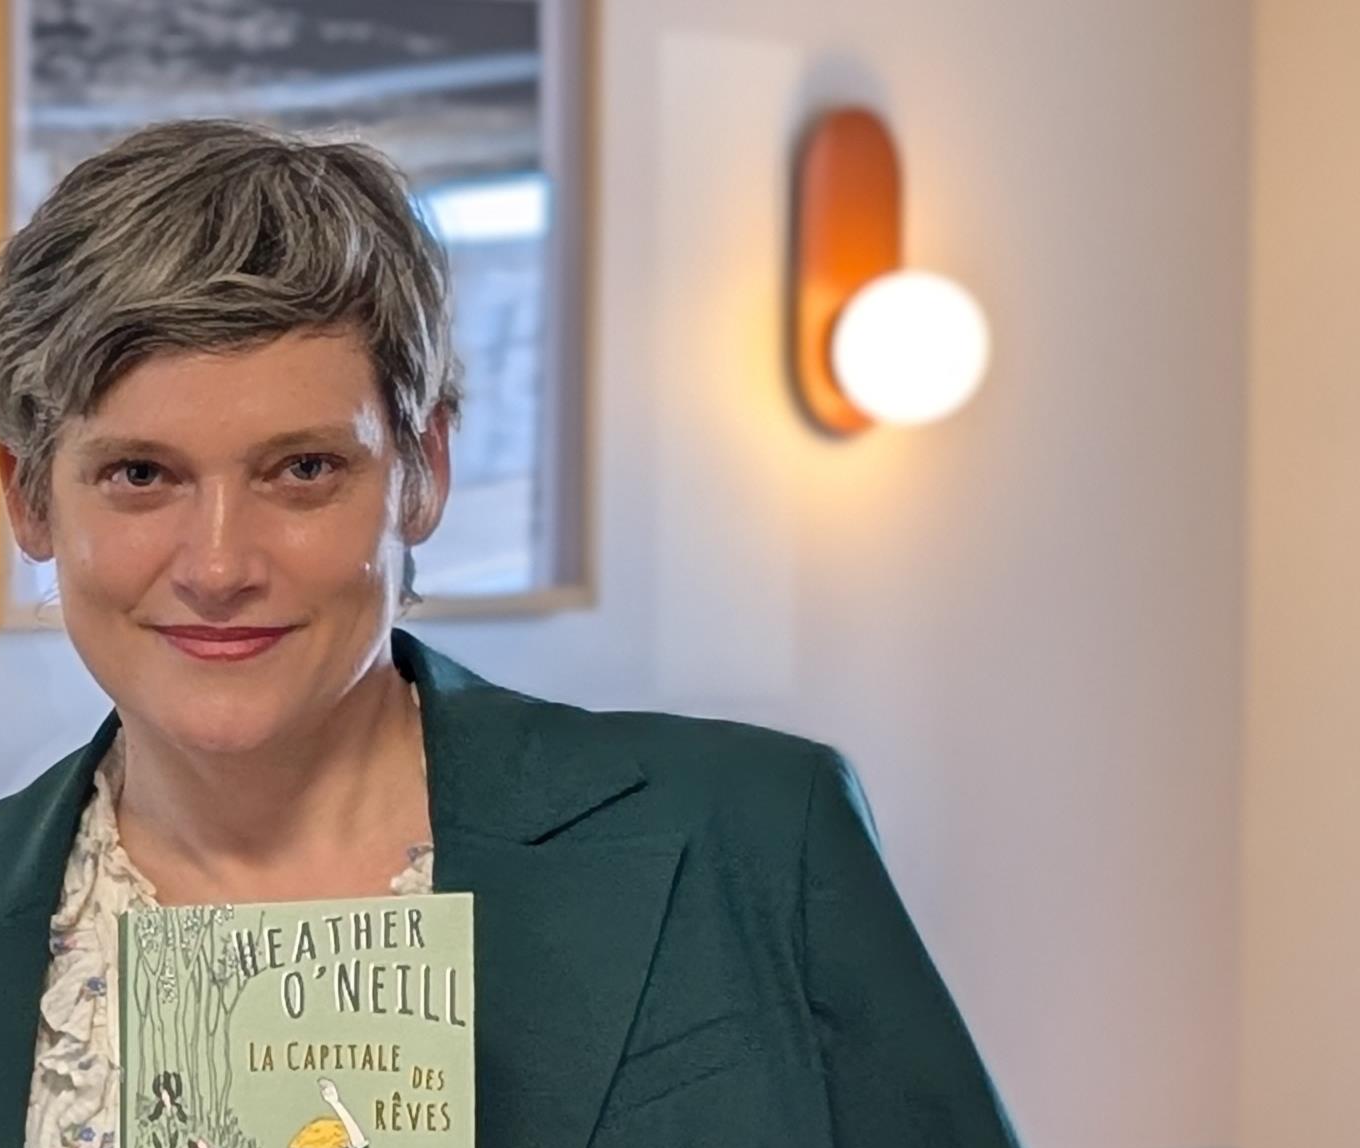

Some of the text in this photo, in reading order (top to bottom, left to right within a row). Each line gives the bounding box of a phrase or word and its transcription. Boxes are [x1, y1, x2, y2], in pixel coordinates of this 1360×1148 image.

[233, 907, 425, 978] HEATHER
[283, 959, 466, 1027] O'NEILL
[250, 1042, 401, 1072] LA CAPITALE
[412, 1066, 445, 1092] DES
[374, 1092, 451, 1132] RÊVES
